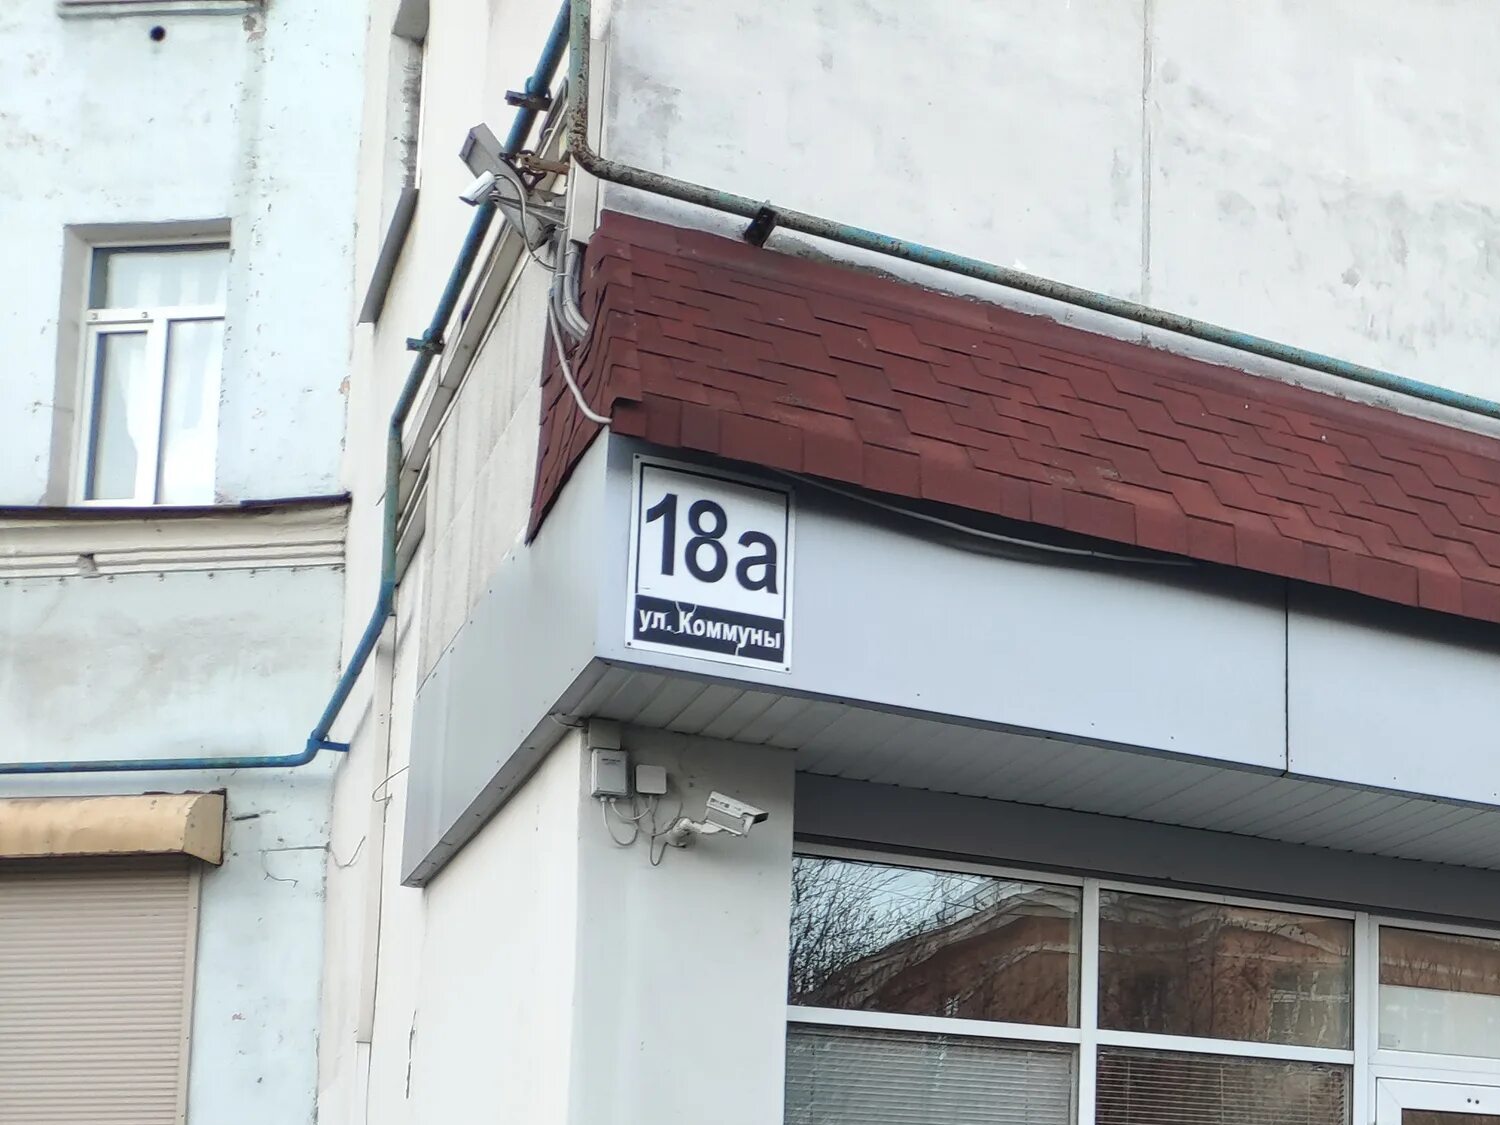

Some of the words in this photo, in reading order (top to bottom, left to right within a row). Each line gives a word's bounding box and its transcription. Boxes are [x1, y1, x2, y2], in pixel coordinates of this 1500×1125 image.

[646, 493, 779, 594] 18а
[639, 610, 672, 632] ул.
[678, 611, 782, 649] Коммуны
